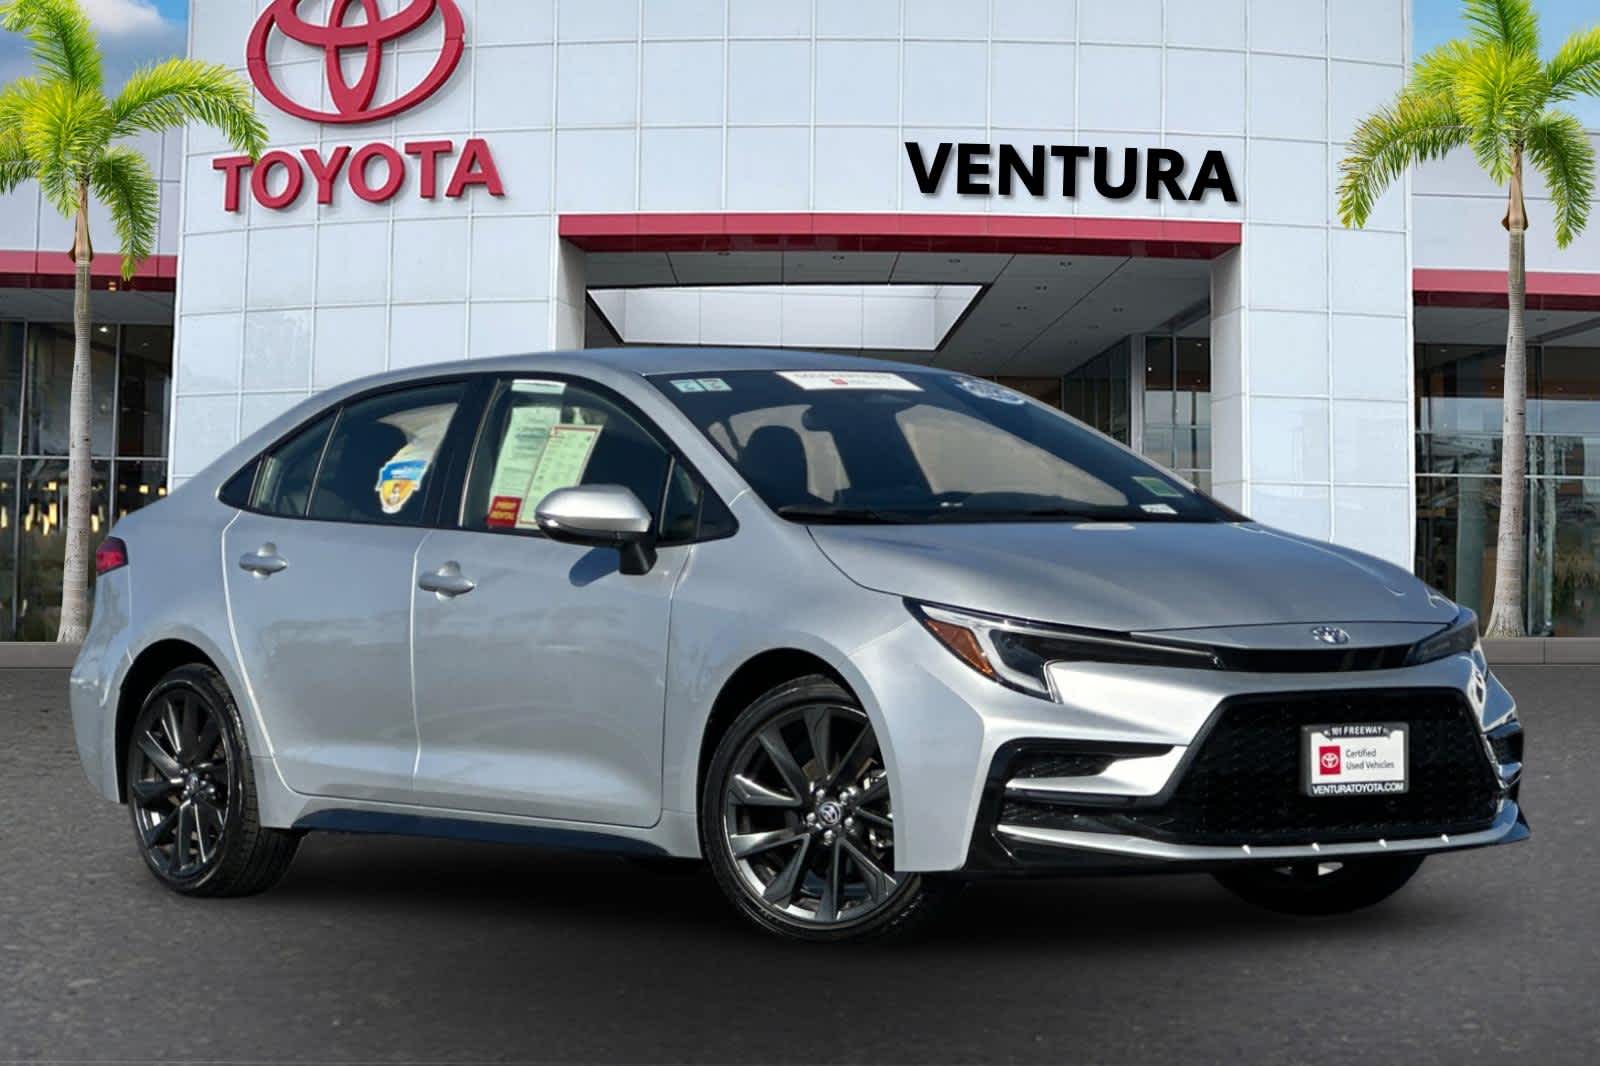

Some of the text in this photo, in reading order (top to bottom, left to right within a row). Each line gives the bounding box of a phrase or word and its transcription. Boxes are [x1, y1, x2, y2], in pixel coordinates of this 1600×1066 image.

[213, 138, 505, 212] TOYOTA
[904, 142, 1239, 202] VENTURA
[1331, 726, 1383, 736] 101 FREEWAY
[1345, 749, 1377, 758] Certified
[1346, 760, 1395, 770] Used Vehicles
[1312, 782, 1404, 794] VENTURATOYOTA.COM
